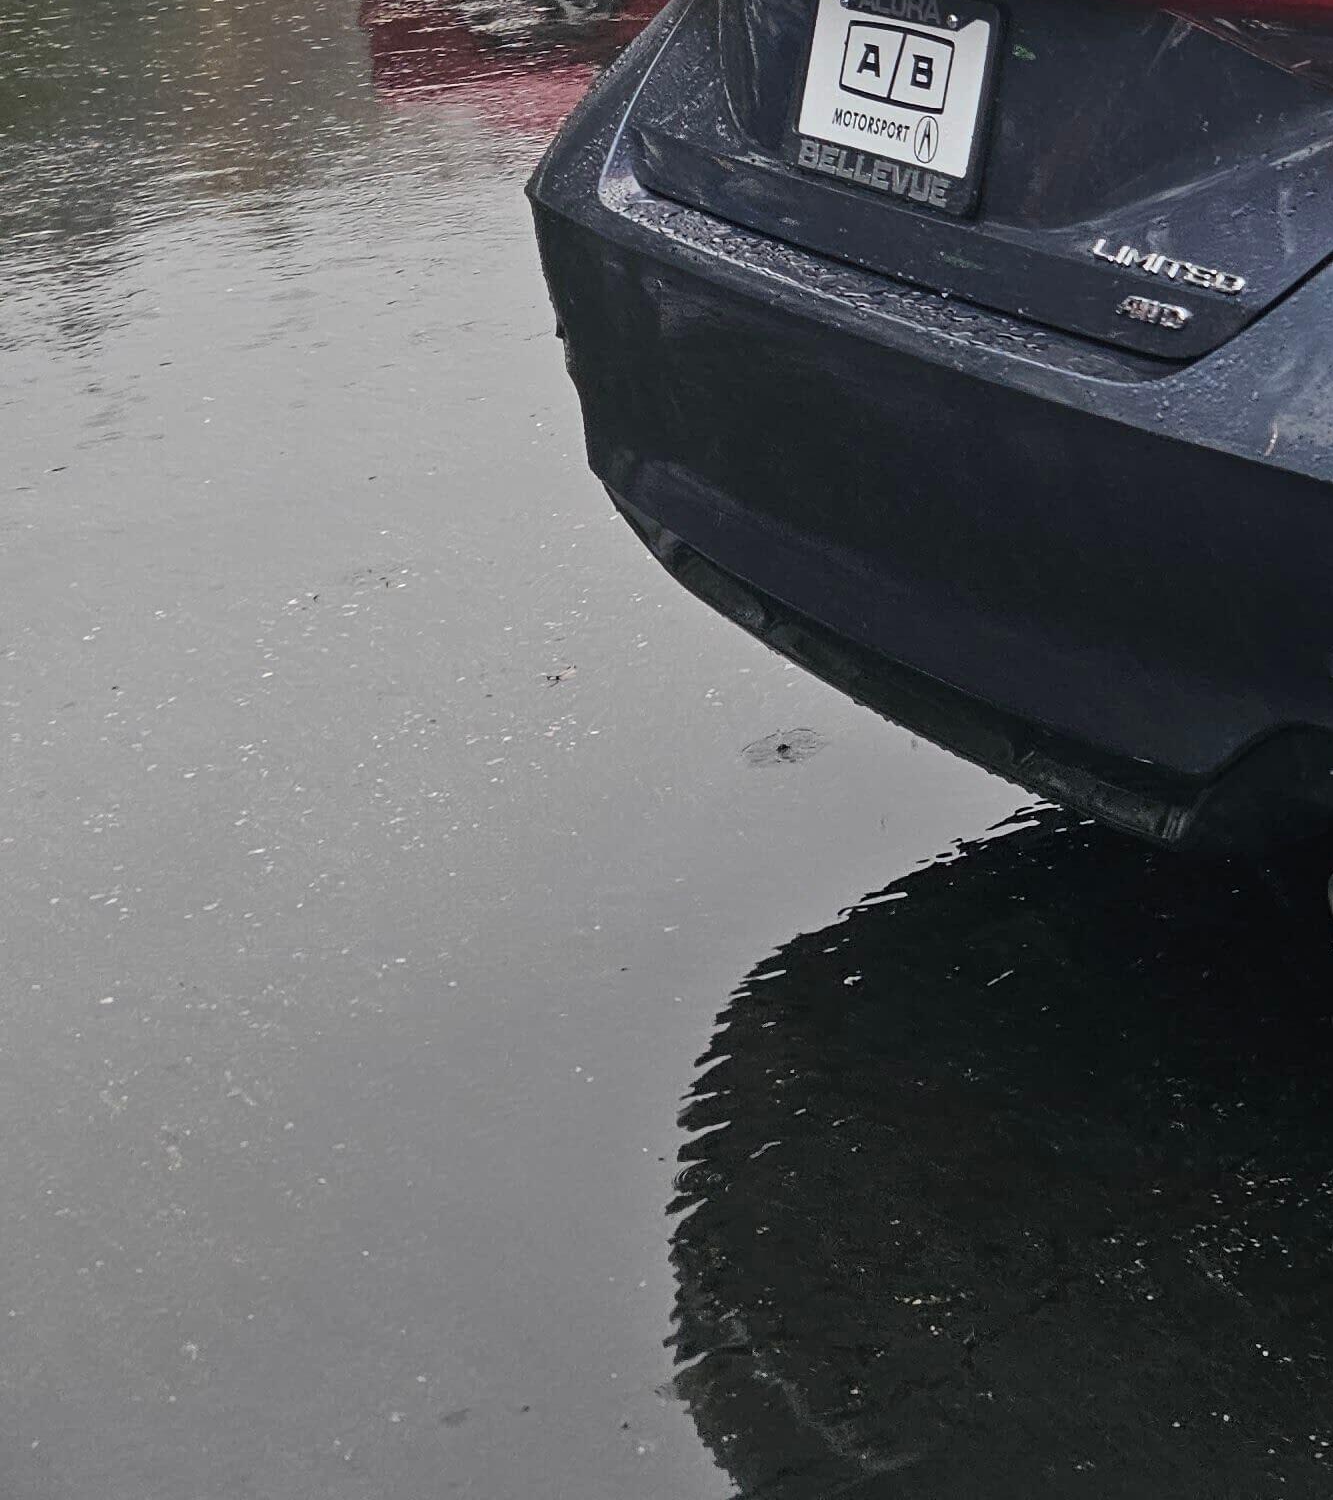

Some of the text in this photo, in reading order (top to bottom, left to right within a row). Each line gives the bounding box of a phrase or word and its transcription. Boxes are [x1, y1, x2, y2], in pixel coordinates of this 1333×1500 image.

[856, 43, 934, 90] A B
[831, 107, 910, 143] MOTORSPORT
[798, 138, 951, 208] BELLEVUE
[1092, 238, 1247, 294] LIMITED
